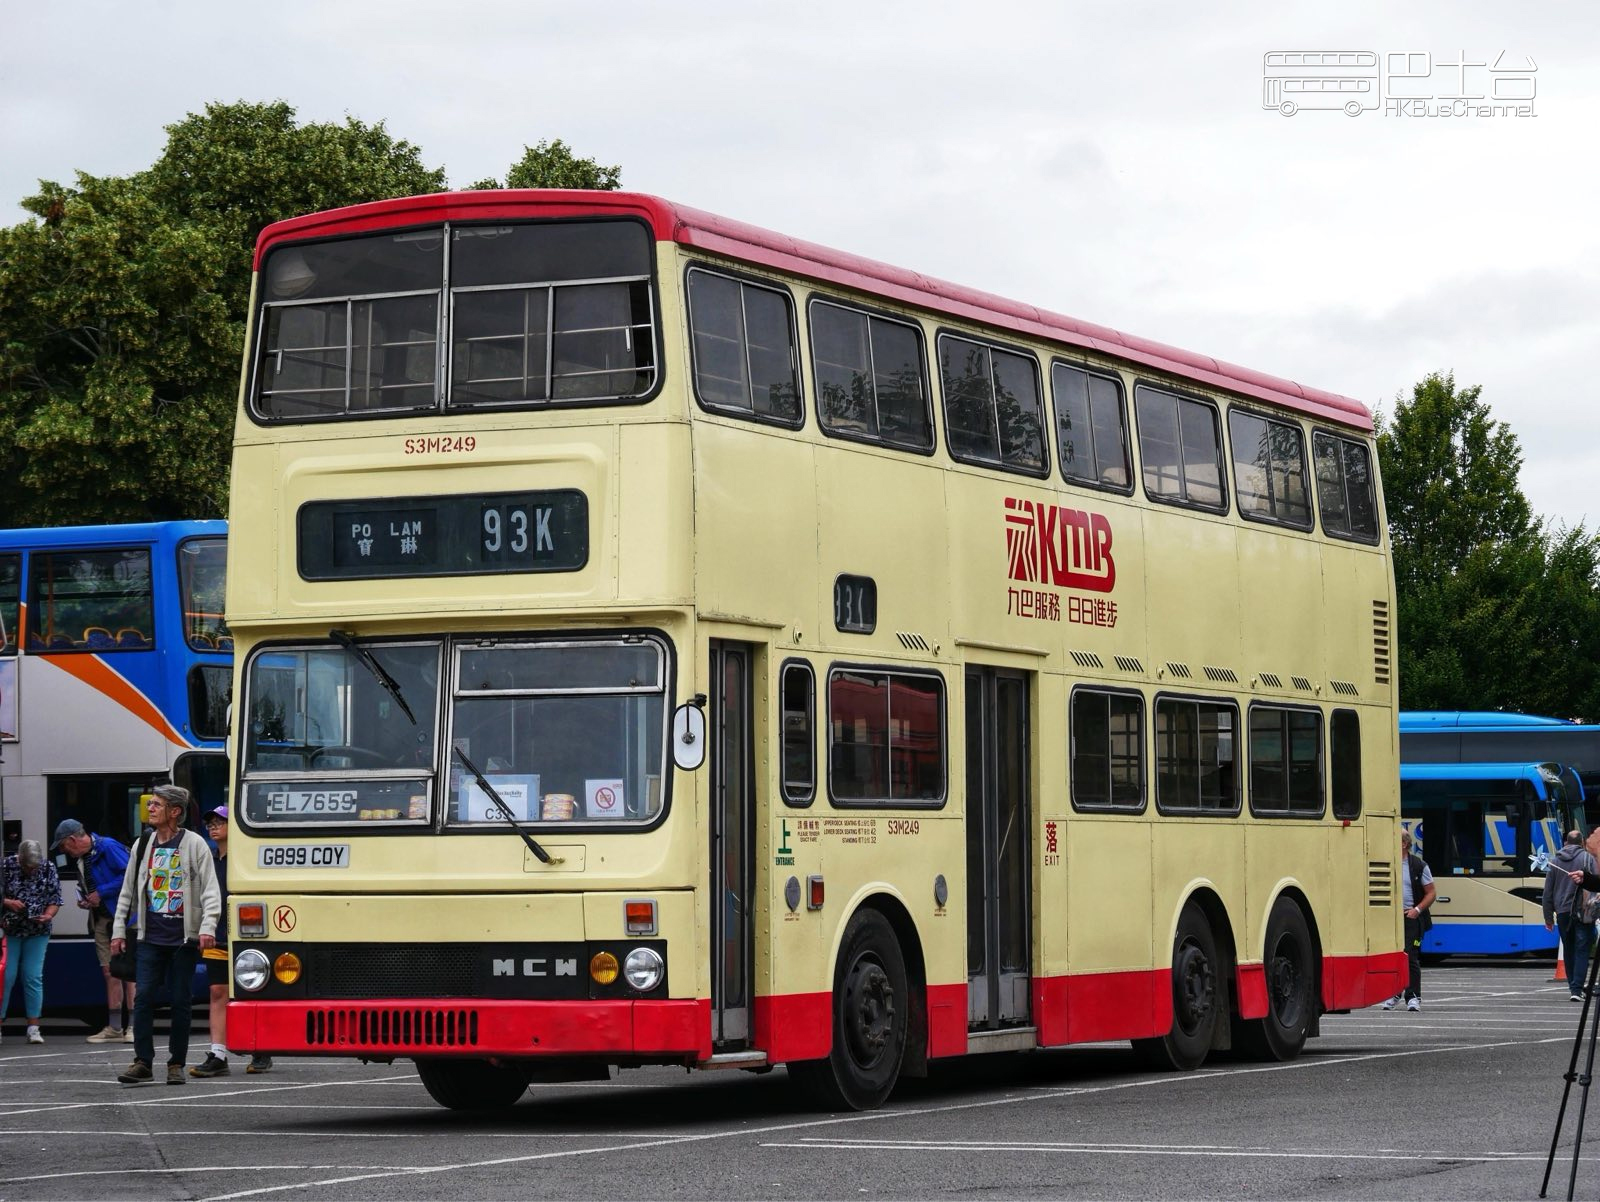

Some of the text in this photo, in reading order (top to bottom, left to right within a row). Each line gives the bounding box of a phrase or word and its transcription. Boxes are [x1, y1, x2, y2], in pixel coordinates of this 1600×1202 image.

[405, 437, 476, 454] S3M249
[352, 521, 422, 538] PO LAM
[484, 508, 554, 552] 93K
[1008, 587, 1117, 628] 九巴服務 日日進步
[888, 820, 920, 835] S3M249
[778, 819, 792, 854] 上
[263, 847, 344, 865] G899 COY
[776, 857, 795, 866] ENTRANCE
[1045, 856, 1060, 866] EXIT
[493, 959, 577, 976] MCW
